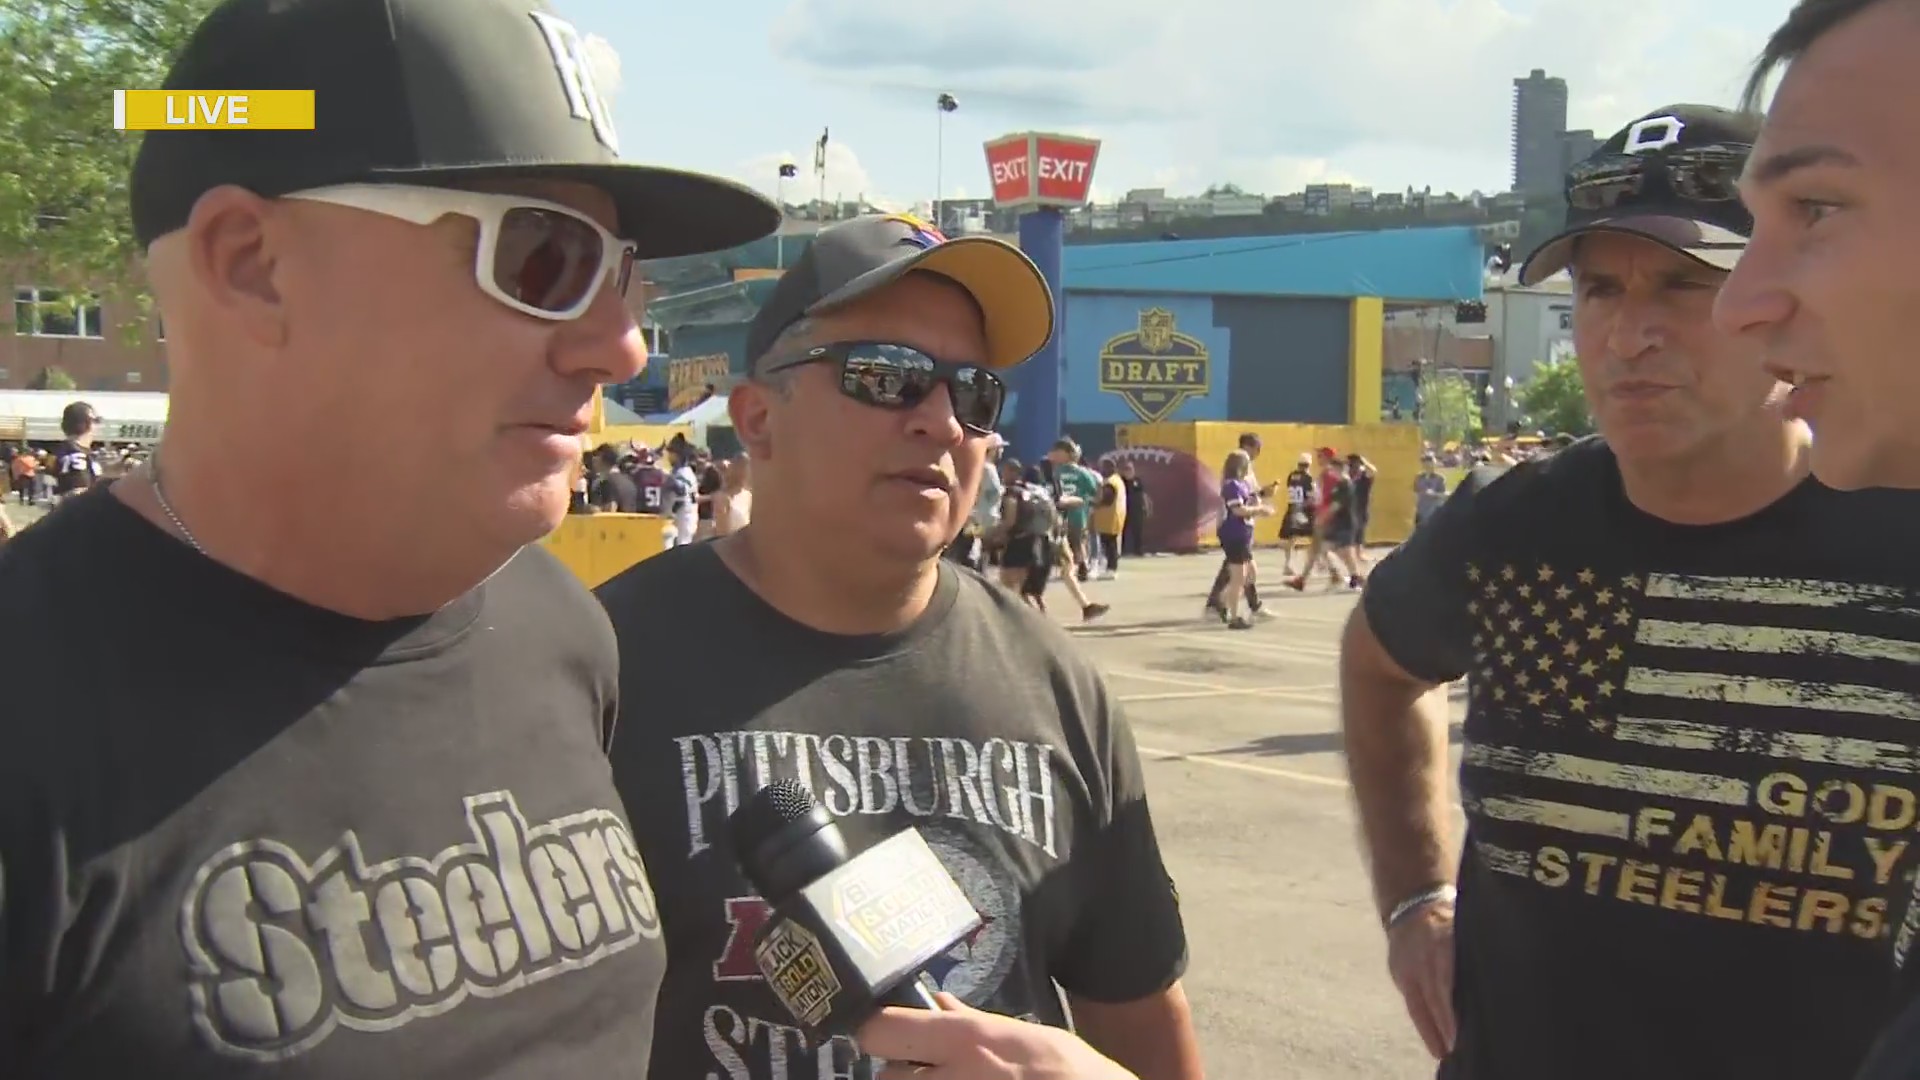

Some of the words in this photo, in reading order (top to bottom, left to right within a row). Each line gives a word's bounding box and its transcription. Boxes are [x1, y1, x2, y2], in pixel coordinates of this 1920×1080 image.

[992, 156, 1028, 184] EXIT
[1038, 156, 1089, 183] EXIT
[1108, 360, 1199, 382] DRAFT
[644, 486, 661, 507] 51
[673, 730, 1058, 860] PITTSBURGH
[183, 790, 662, 1060] Steelers
